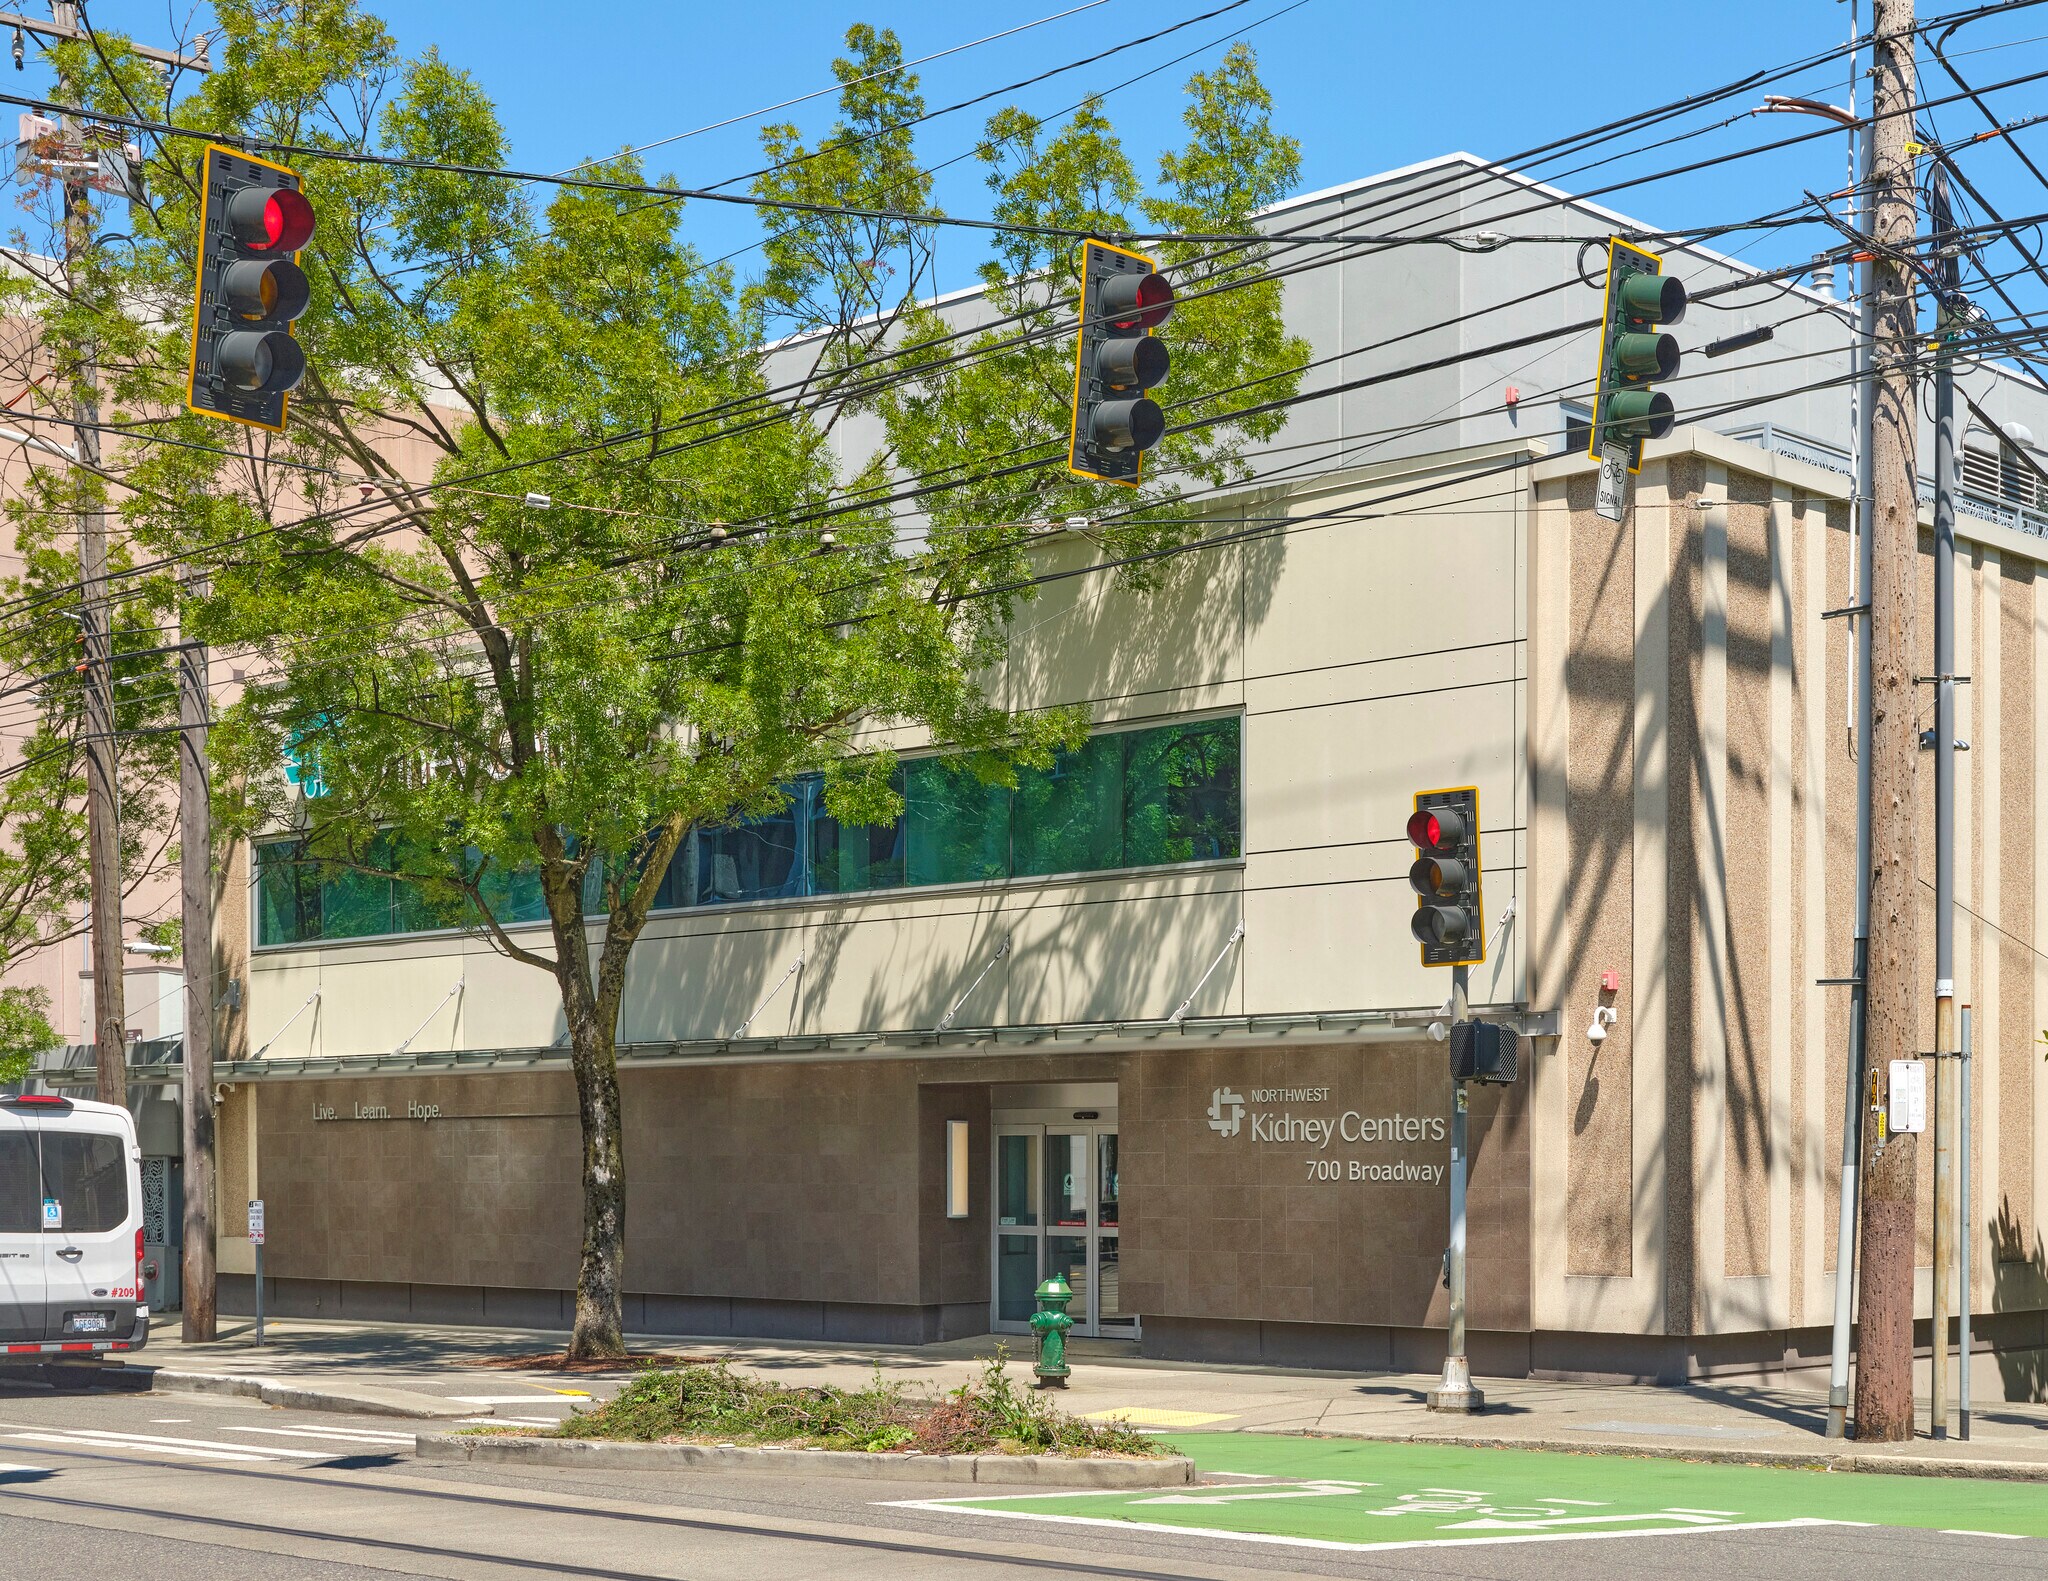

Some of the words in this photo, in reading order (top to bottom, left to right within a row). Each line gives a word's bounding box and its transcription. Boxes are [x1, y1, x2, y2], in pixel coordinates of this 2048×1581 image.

[1600, 491, 1621, 507] SIGNAL
[1251, 1088, 1329, 1103] NORTHWEST
[312, 1102, 338, 1120] Live.
[354, 1101, 391, 1119] Learn.
[407, 1100, 442, 1122] Hope.
[1251, 1112, 1336, 1149] Kidney
[1340, 1111, 1446, 1142] Centers
[1306, 1161, 1341, 1181] 700
[1348, 1160, 1444, 1186] Broadway
[110, 1287, 135, 1298] #209
